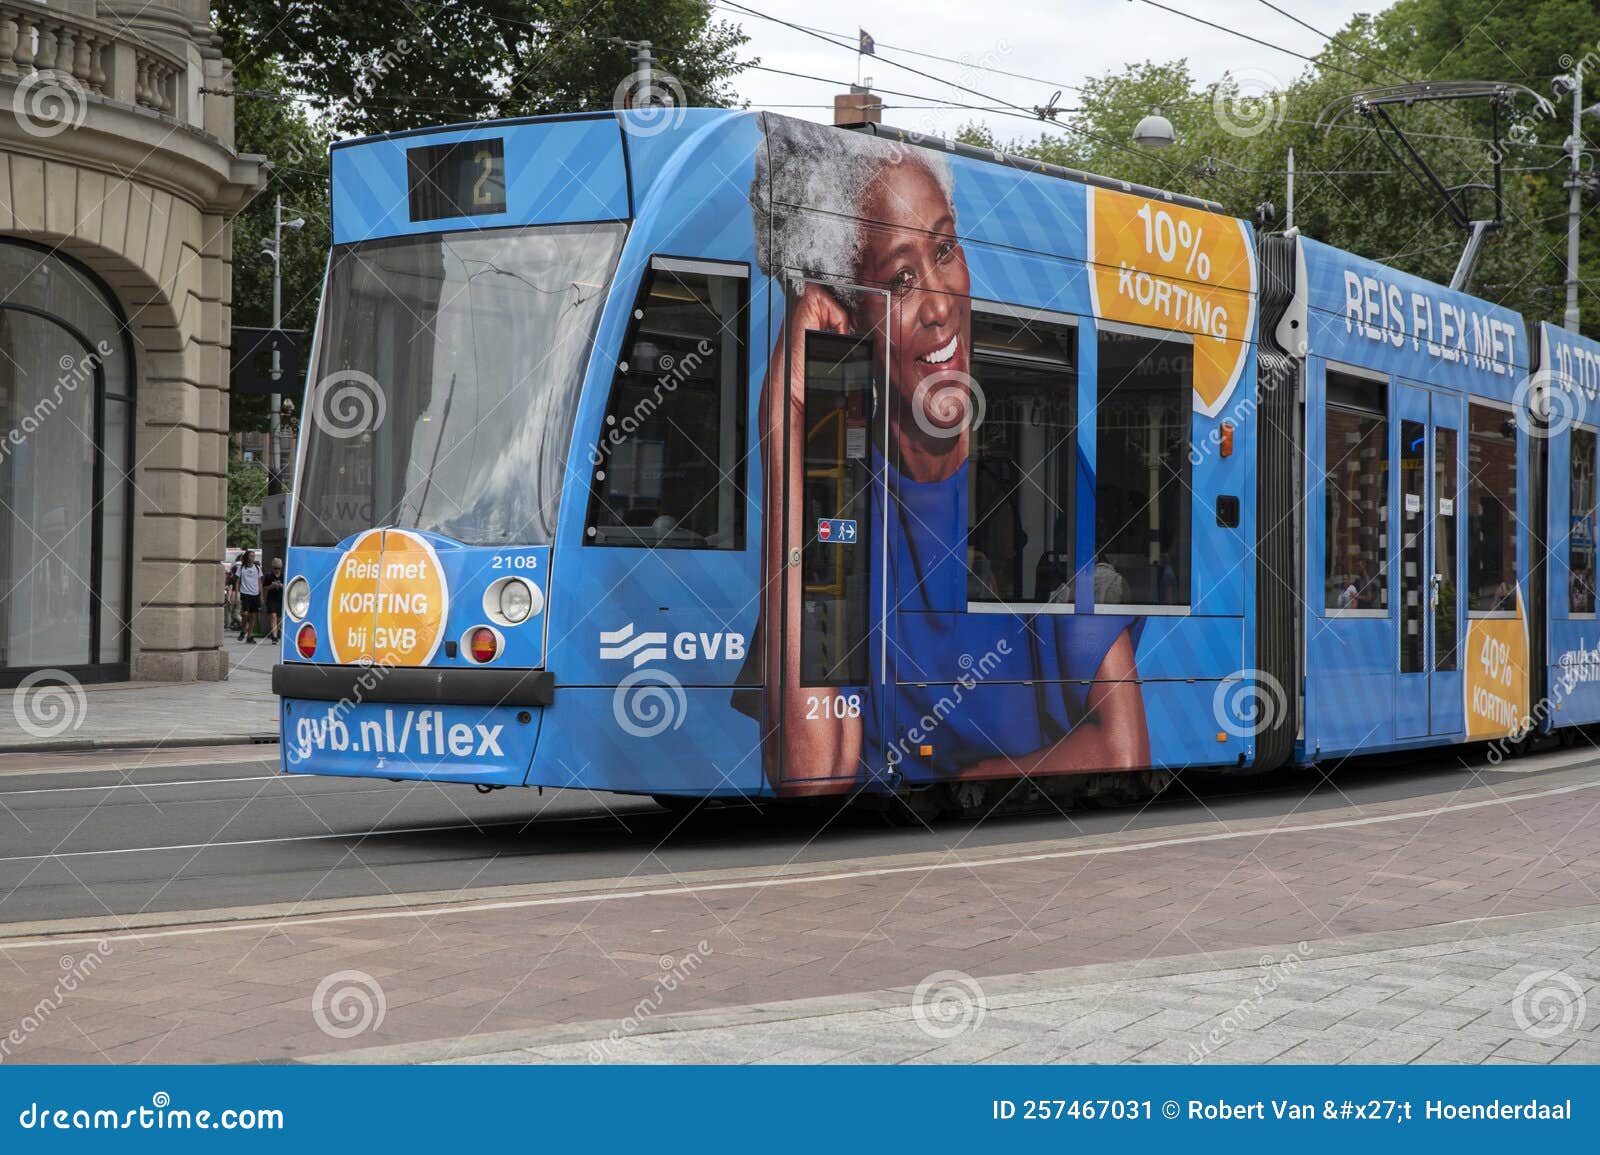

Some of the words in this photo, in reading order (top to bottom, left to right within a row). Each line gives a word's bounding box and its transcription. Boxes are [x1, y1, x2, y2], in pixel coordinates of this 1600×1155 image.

[474, 150, 492, 204] 2
[1137, 203, 1211, 281] 10%
[1118, 261, 1228, 344] KORTING
[1344, 270, 1405, 348] REIS
[1411, 292, 1469, 366] FLEX
[1471, 311, 1516, 378] MET
[344, 557, 380, 580] Reis
[386, 559, 426, 580] met
[491, 556, 537, 570] 2108
[338, 592, 428, 615] KORTING
[347, 627, 367, 653] bij
[373, 627, 417, 649] GVB
[672, 631, 745, 660] GVB
[1480, 634, 1512, 688] 40%
[805, 694, 861, 720] 2108
[1472, 684, 1518, 731] KORTING
[296, 707, 505, 760] gvb.nl/flex
